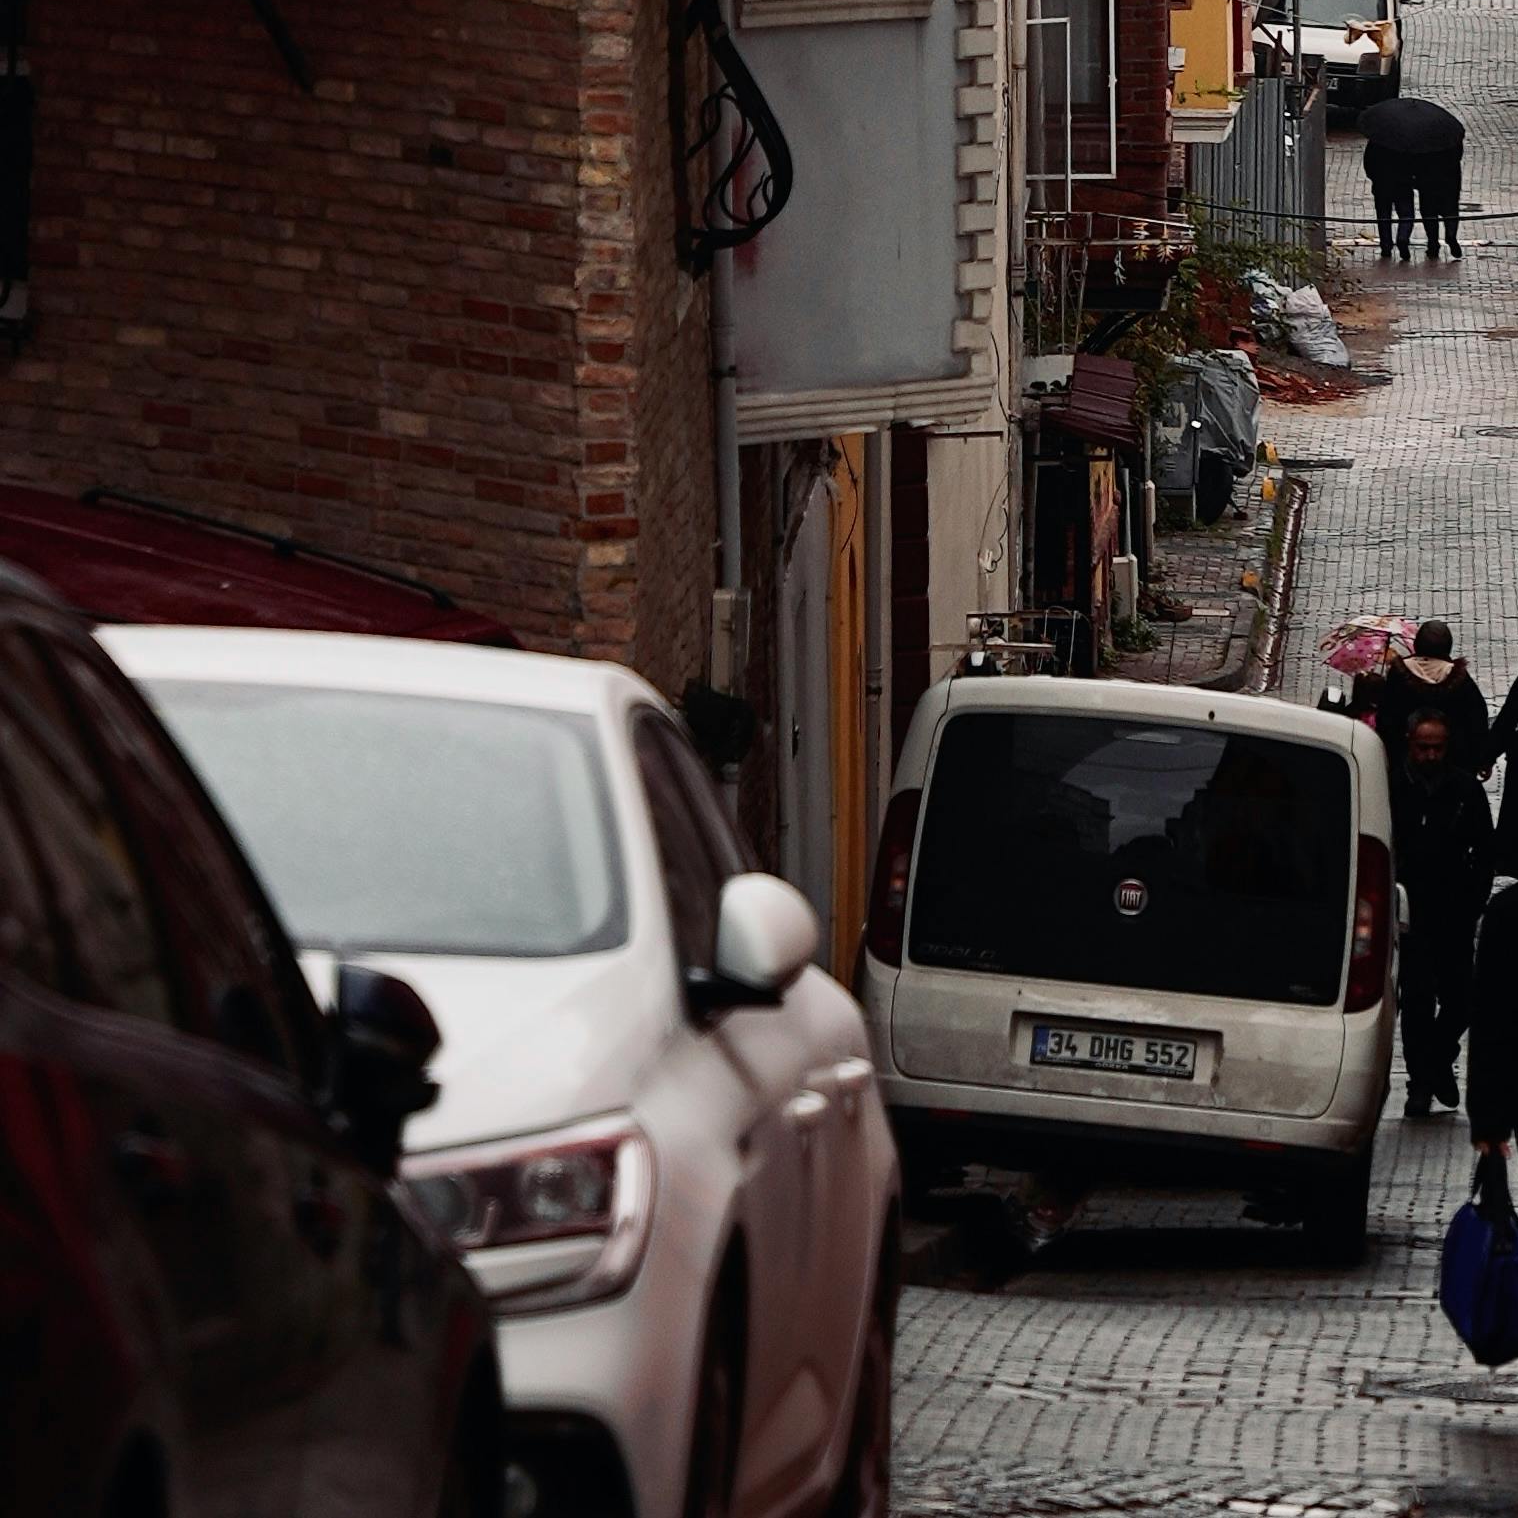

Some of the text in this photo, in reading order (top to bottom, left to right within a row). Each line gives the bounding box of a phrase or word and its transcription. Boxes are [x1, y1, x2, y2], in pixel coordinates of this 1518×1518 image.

[1120, 889, 1142, 907] FIAT
[1049, 1032, 1189, 1068] 34 DHG 552
